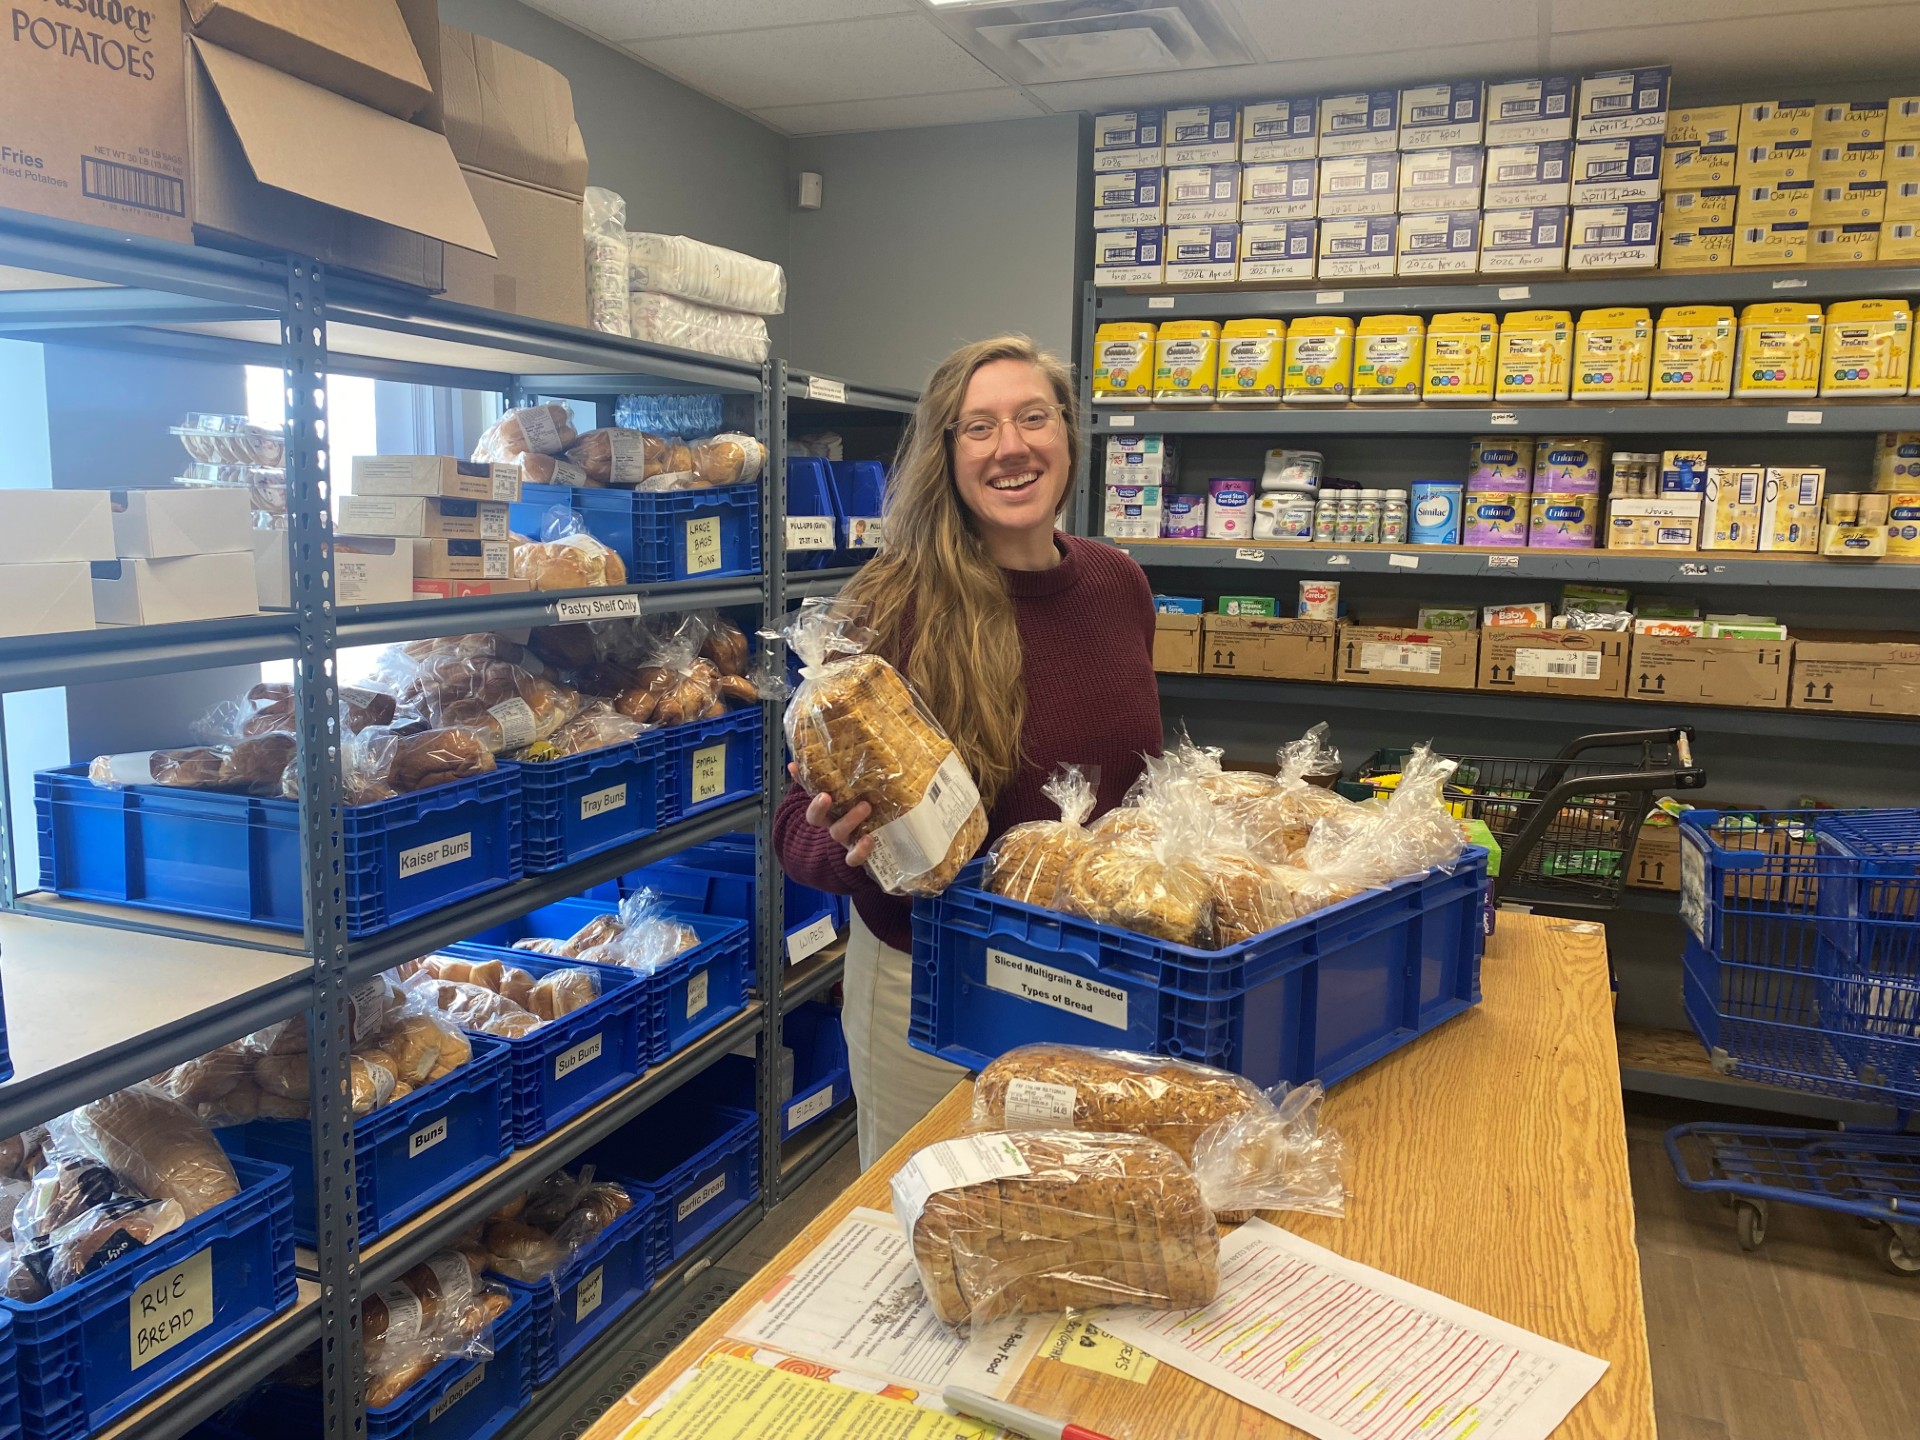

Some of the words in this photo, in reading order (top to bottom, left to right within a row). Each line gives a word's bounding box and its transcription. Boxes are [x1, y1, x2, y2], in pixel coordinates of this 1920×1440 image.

[12, 8, 155, 81] POTATOES
[1589, 121, 1618, 134] April
[1635, 117, 1665, 128] 2026
[2, 146, 44, 168] Fries
[94, 145, 110, 155] NET
[112, 150, 126, 161] WT
[128, 154, 137, 164] 30
[139, 156, 149, 166] LB
[162, 153, 182, 165] BAGS
[25, 171, 68, 188] Potatoes
[1483, 452, 1514, 462] Enfamil
[1551, 453, 1584, 463] Enfamil
[1228, 498, 1246, 506] Départ
[1233, 492, 1246, 500] Start
[1417, 508, 1448, 517] Similac
[1480, 507, 1512, 517] Enfamil
[1549, 508, 1581, 518] Enfamil
[689, 521, 711, 534] LARGE
[790, 521, 813, 530] PULL-UPS
[694, 535, 712, 550] BAGS
[1451, 531, 1456, 540] 1
[560, 602, 591, 616] Pastry
[593, 599, 616, 613] Shelf
[618, 597, 638, 613] Only
[1499, 610, 1526, 619] Baby
[695, 757, 719, 770] SMALL
[702, 766, 715, 779] PKG
[700, 784, 717, 796] BUNS
[583, 798, 603, 815] Tray
[602, 789, 626, 808] Buns
[401, 849, 439, 870] Kaiser
[441, 838, 470, 859] Buns
[800, 926, 826, 950] WIPES
[994, 954, 1023, 972] Sliced
[1024, 963, 1073, 987] Multigrain
[1075, 979, 1083, 989] &
[1085, 982, 1124, 1002] Seeded
[1021, 983, 1050, 1002] Types
[1052, 993, 1062, 1004] of
[1063, 996, 1093, 1013] Bread
[558, 1054, 577, 1074] Sub
[578, 1042, 601, 1067] Buns
[796, 1101, 815, 1120] SIZE
[818, 1095, 824, 1108] 2
[414, 1125, 444, 1150] Buns
[678, 1194, 703, 1218] Garlic
[702, 1179, 726, 1202] Bread
[140, 1273, 186, 1318] RYE
[577, 1275, 603, 1299] Hamburger
[137, 1308, 195, 1356] BREAD
[995, 1332, 1023, 1353] Baby
[984, 1353, 1010, 1374] Food
[435, 1402, 450, 1417] Hot
[449, 1390, 465, 1409] Dog
[464, 1374, 483, 1394] Buns
